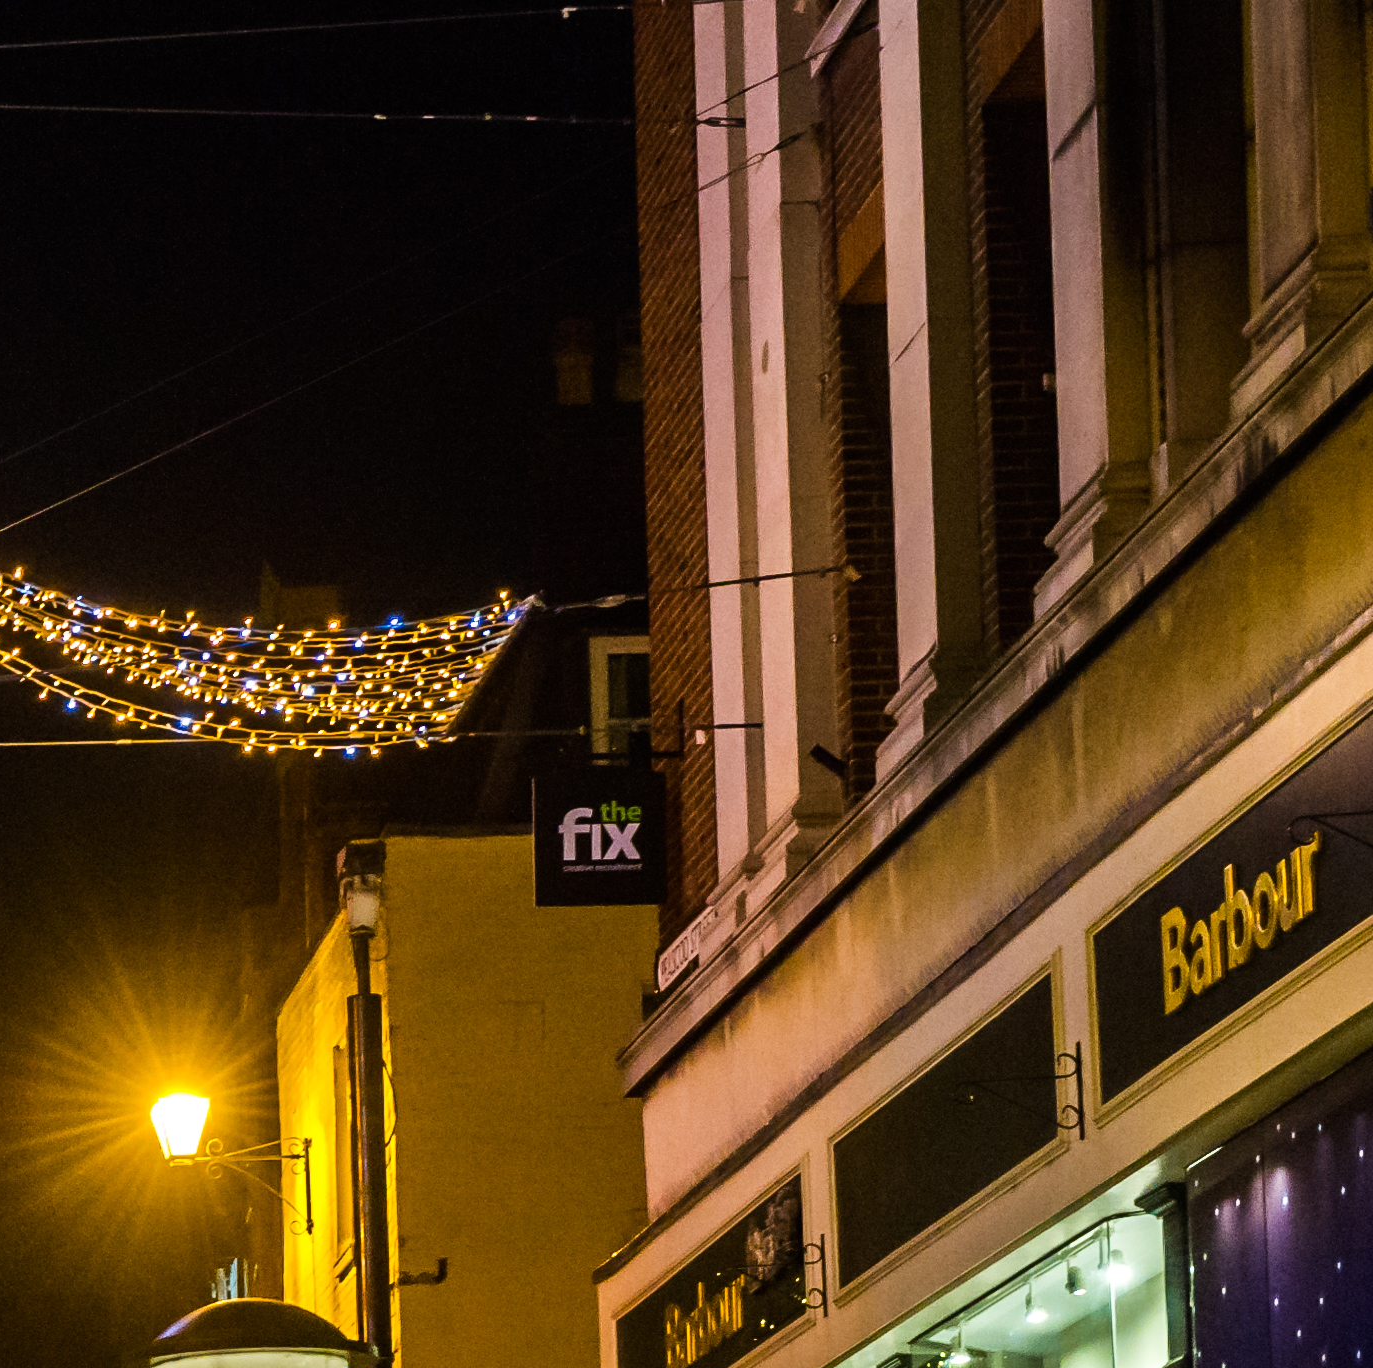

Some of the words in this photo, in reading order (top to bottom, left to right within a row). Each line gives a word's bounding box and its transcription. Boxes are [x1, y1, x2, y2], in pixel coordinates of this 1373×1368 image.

[558, 807, 641, 861] fix
[600, 800, 642, 822] the
[1160, 830, 1322, 1016] Barbour
